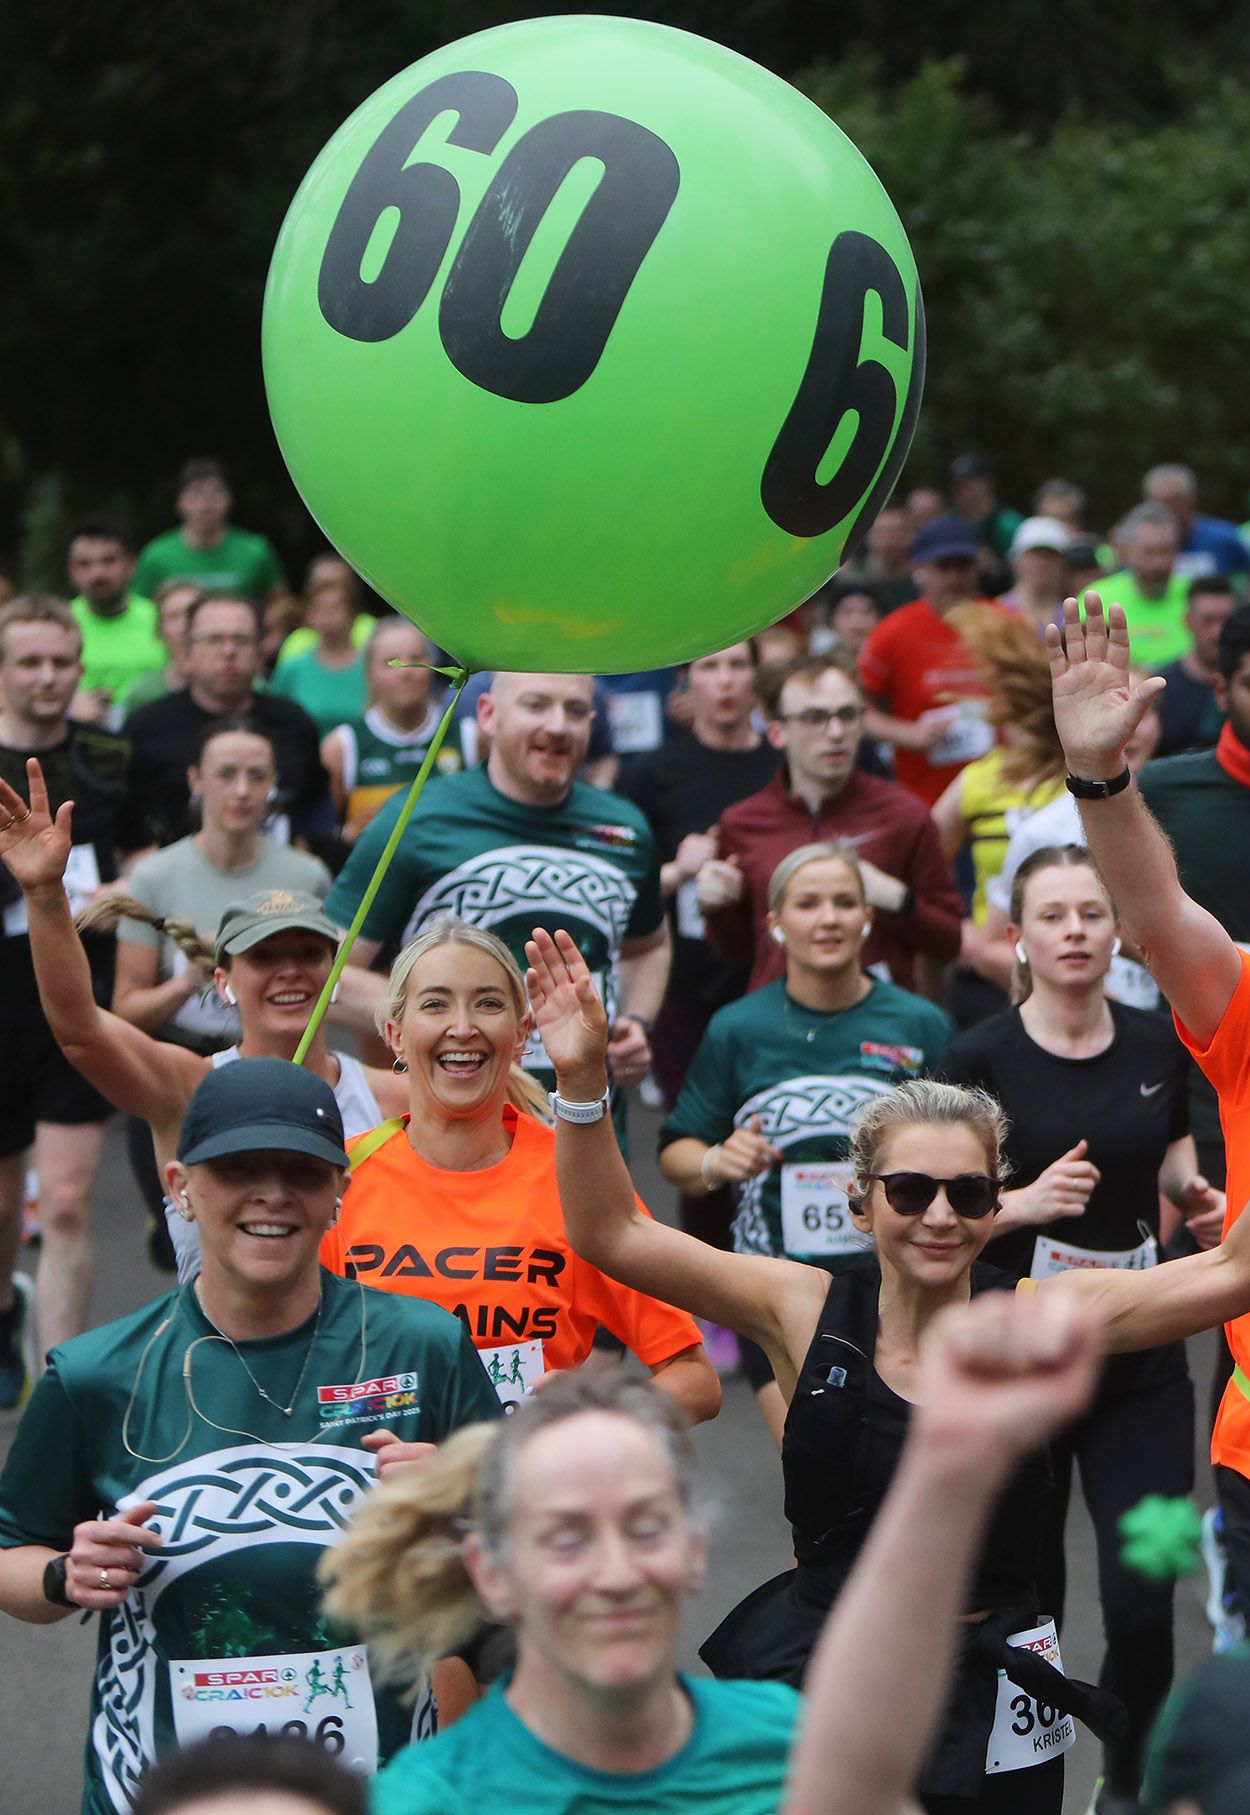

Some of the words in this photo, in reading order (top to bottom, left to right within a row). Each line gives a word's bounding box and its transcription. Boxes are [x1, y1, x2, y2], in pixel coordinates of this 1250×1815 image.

[317, 70, 680, 404] 60
[760, 230, 927, 567] 6
[803, 1203, 846, 1232] 65
[345, 1243, 567, 1288] PACER
[332, 1379, 398, 1400] SPAR
[207, 1670, 278, 1686] SPAR
[1010, 1694, 1067, 1736] 36
